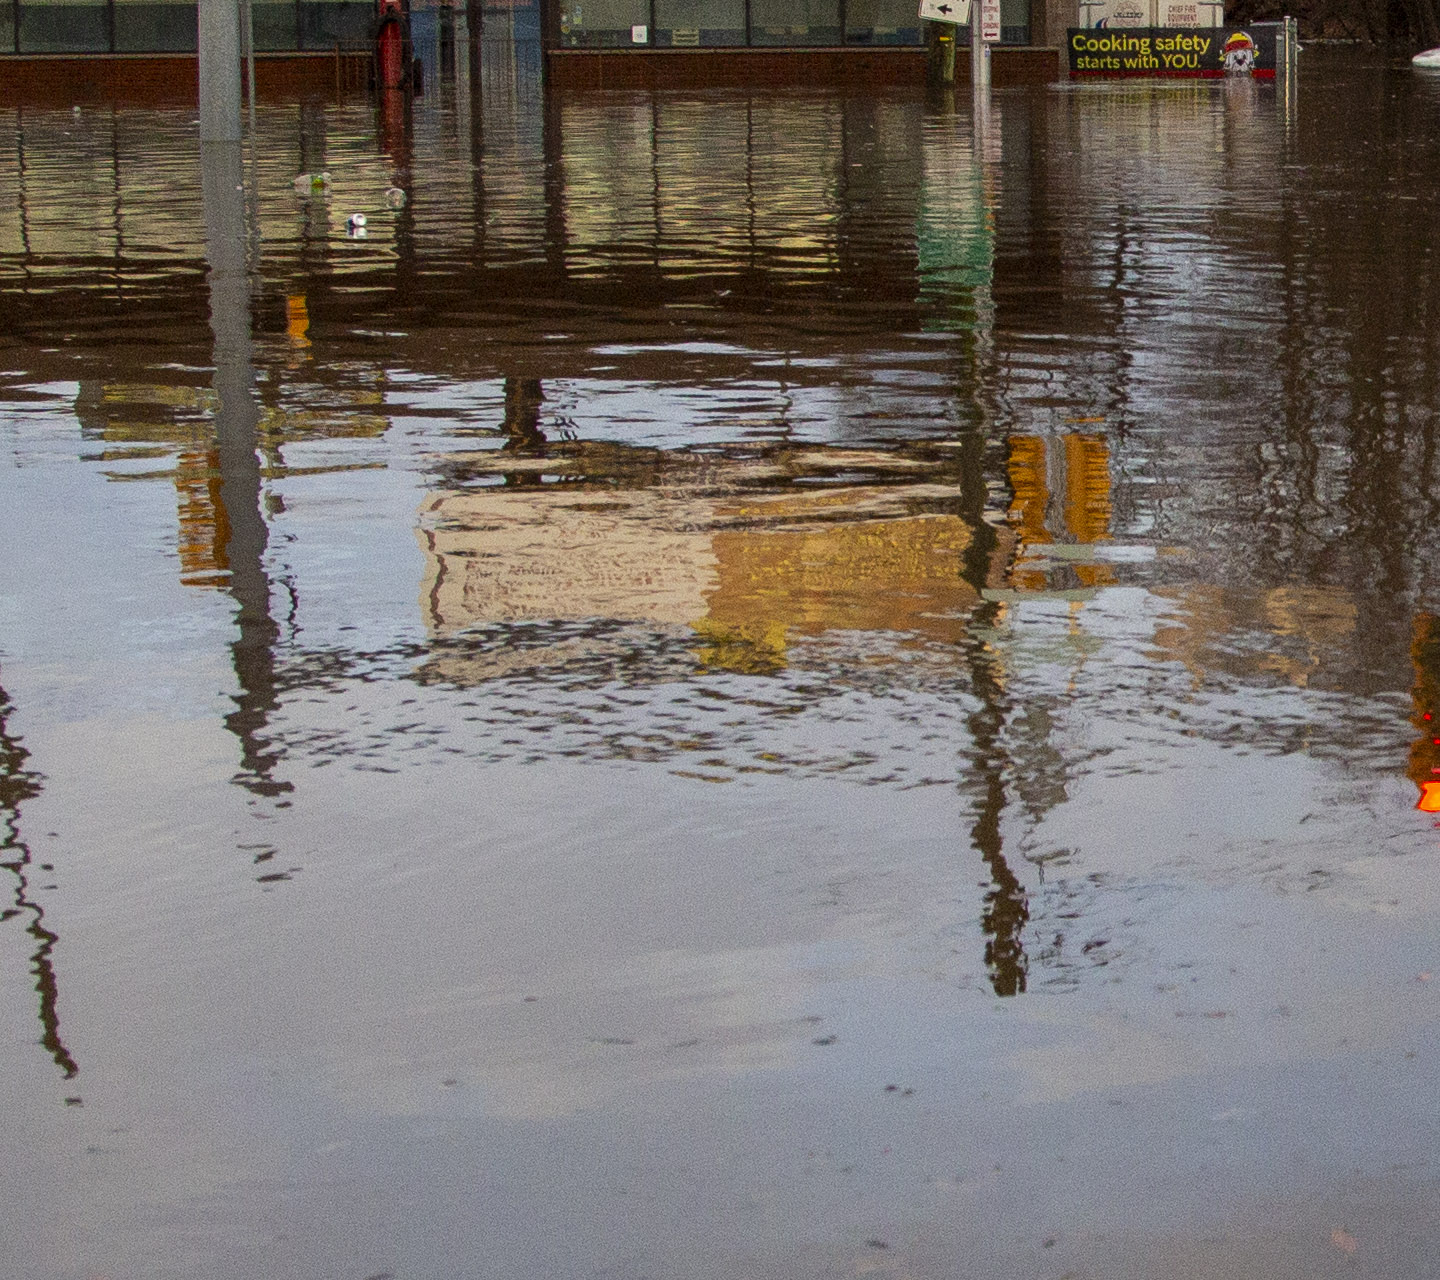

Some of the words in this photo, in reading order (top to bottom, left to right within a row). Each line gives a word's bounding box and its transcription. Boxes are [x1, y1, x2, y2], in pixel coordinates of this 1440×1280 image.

[1072, 34, 1151, 55] Cooking
[1155, 34, 1211, 55] safety
[1076, 55, 1120, 69] starts
[1123, 54, 1158, 69] with
[1162, 54, 1201, 69] YOU.
